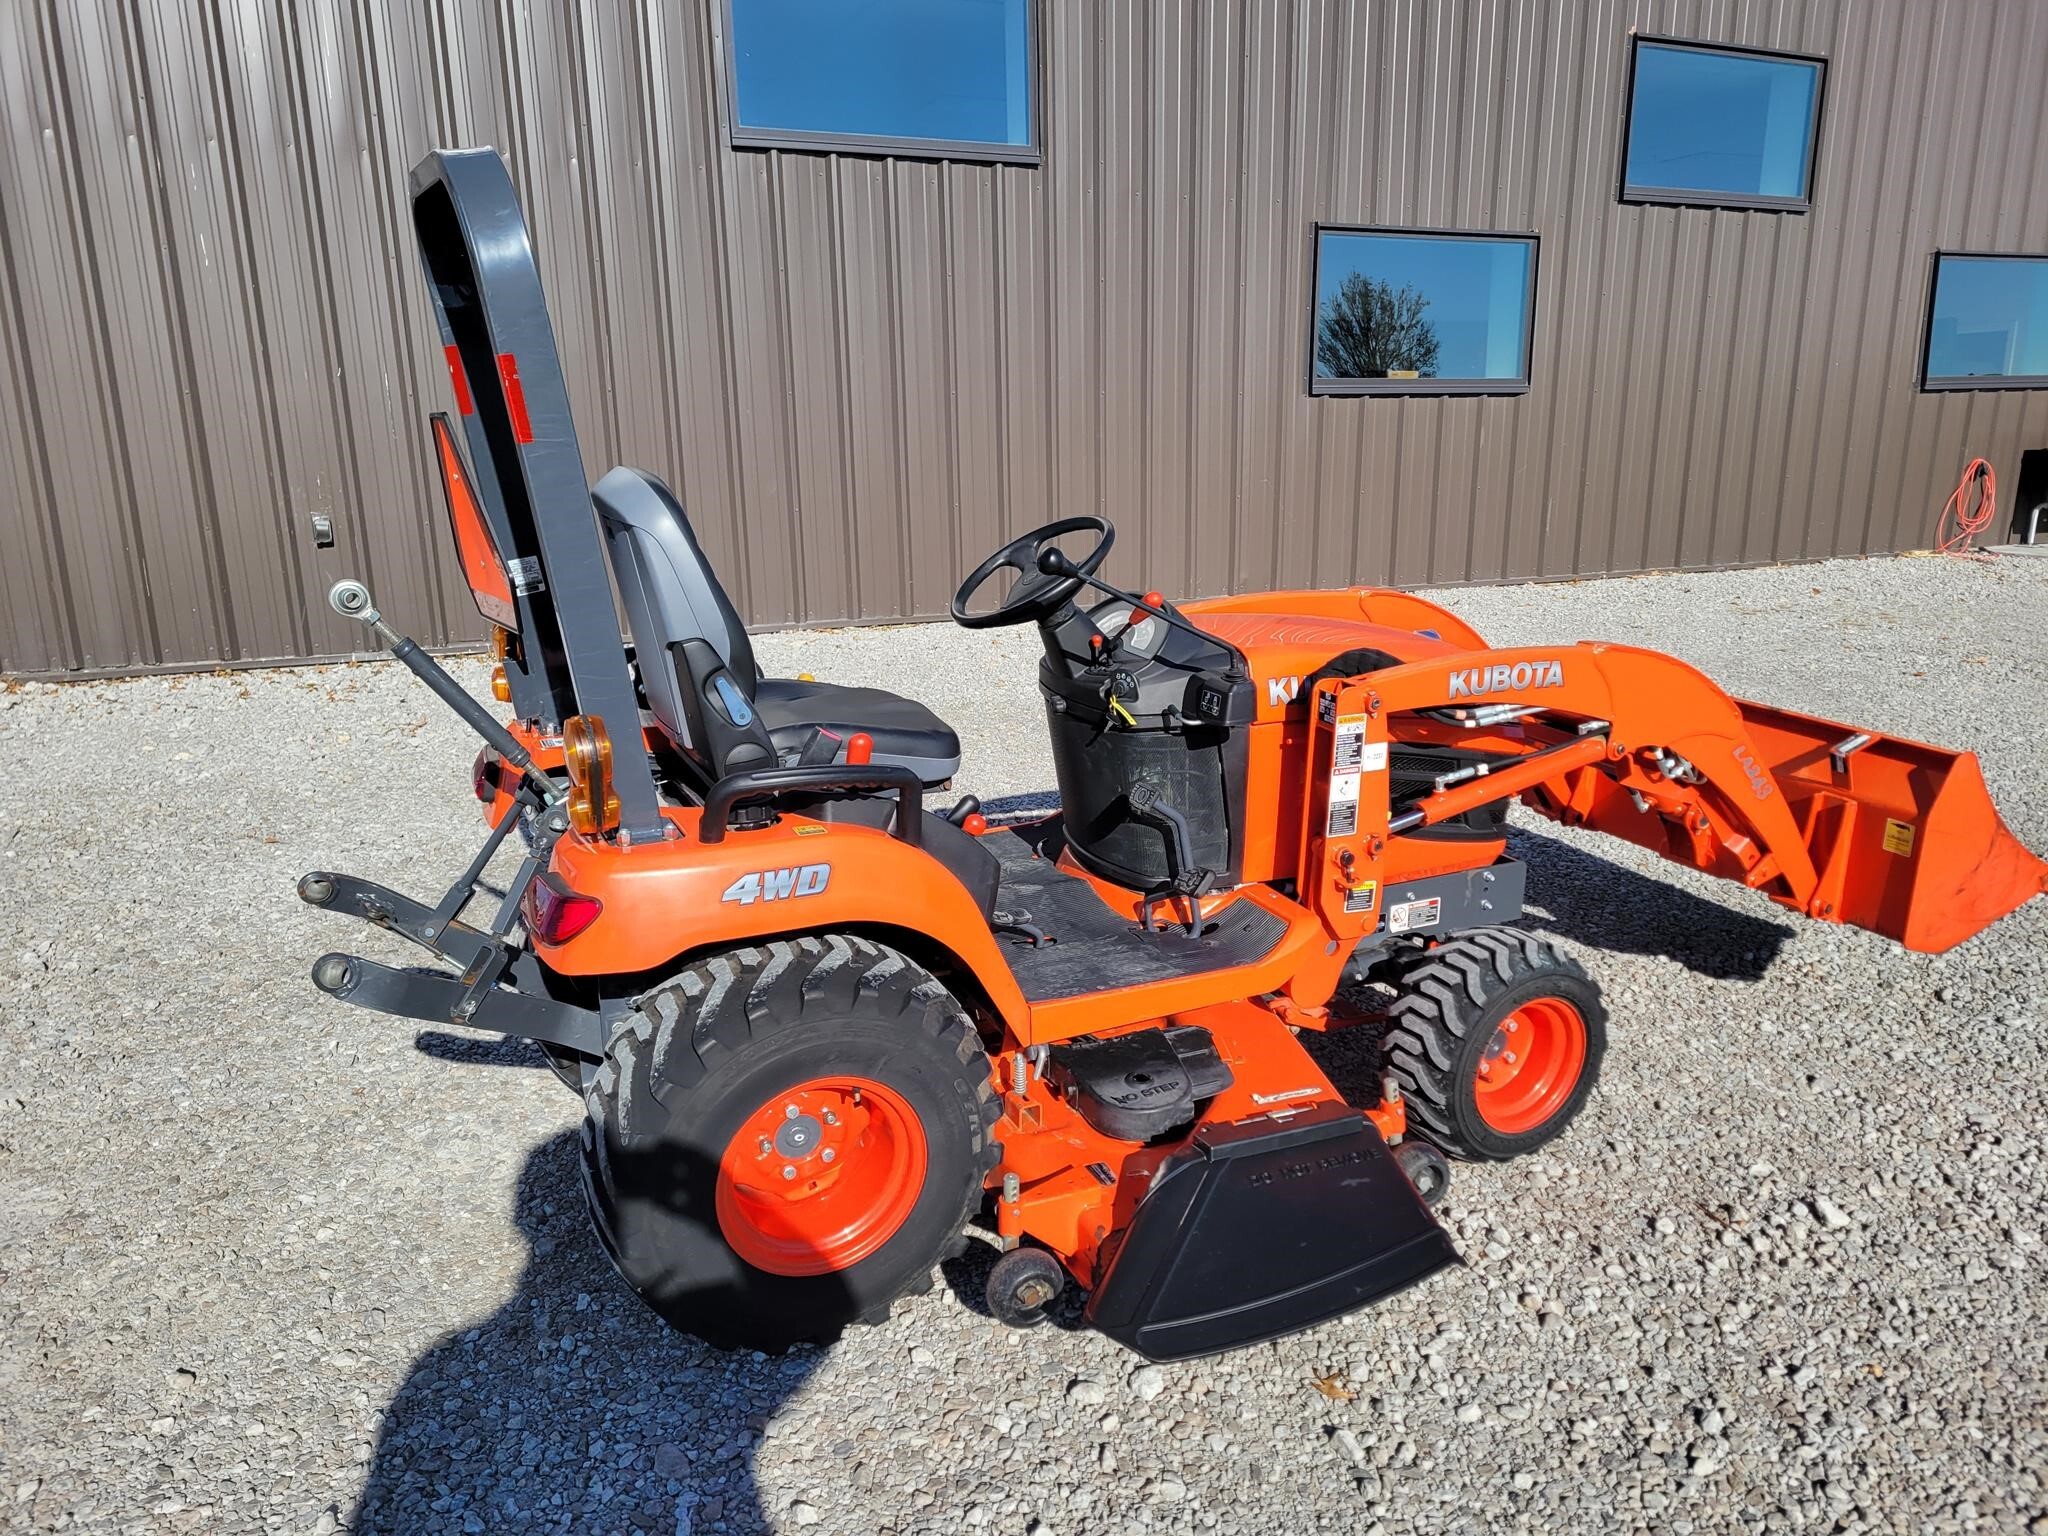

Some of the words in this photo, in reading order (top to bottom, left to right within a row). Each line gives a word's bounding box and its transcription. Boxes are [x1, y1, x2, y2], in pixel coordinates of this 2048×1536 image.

[1449, 660, 1564, 699] KUBOTA
[1732, 744, 1774, 800] LA243
[721, 862, 832, 906] 4WD
[1110, 1093, 1138, 1104] NO
[1141, 1081, 1180, 1097] STEP
